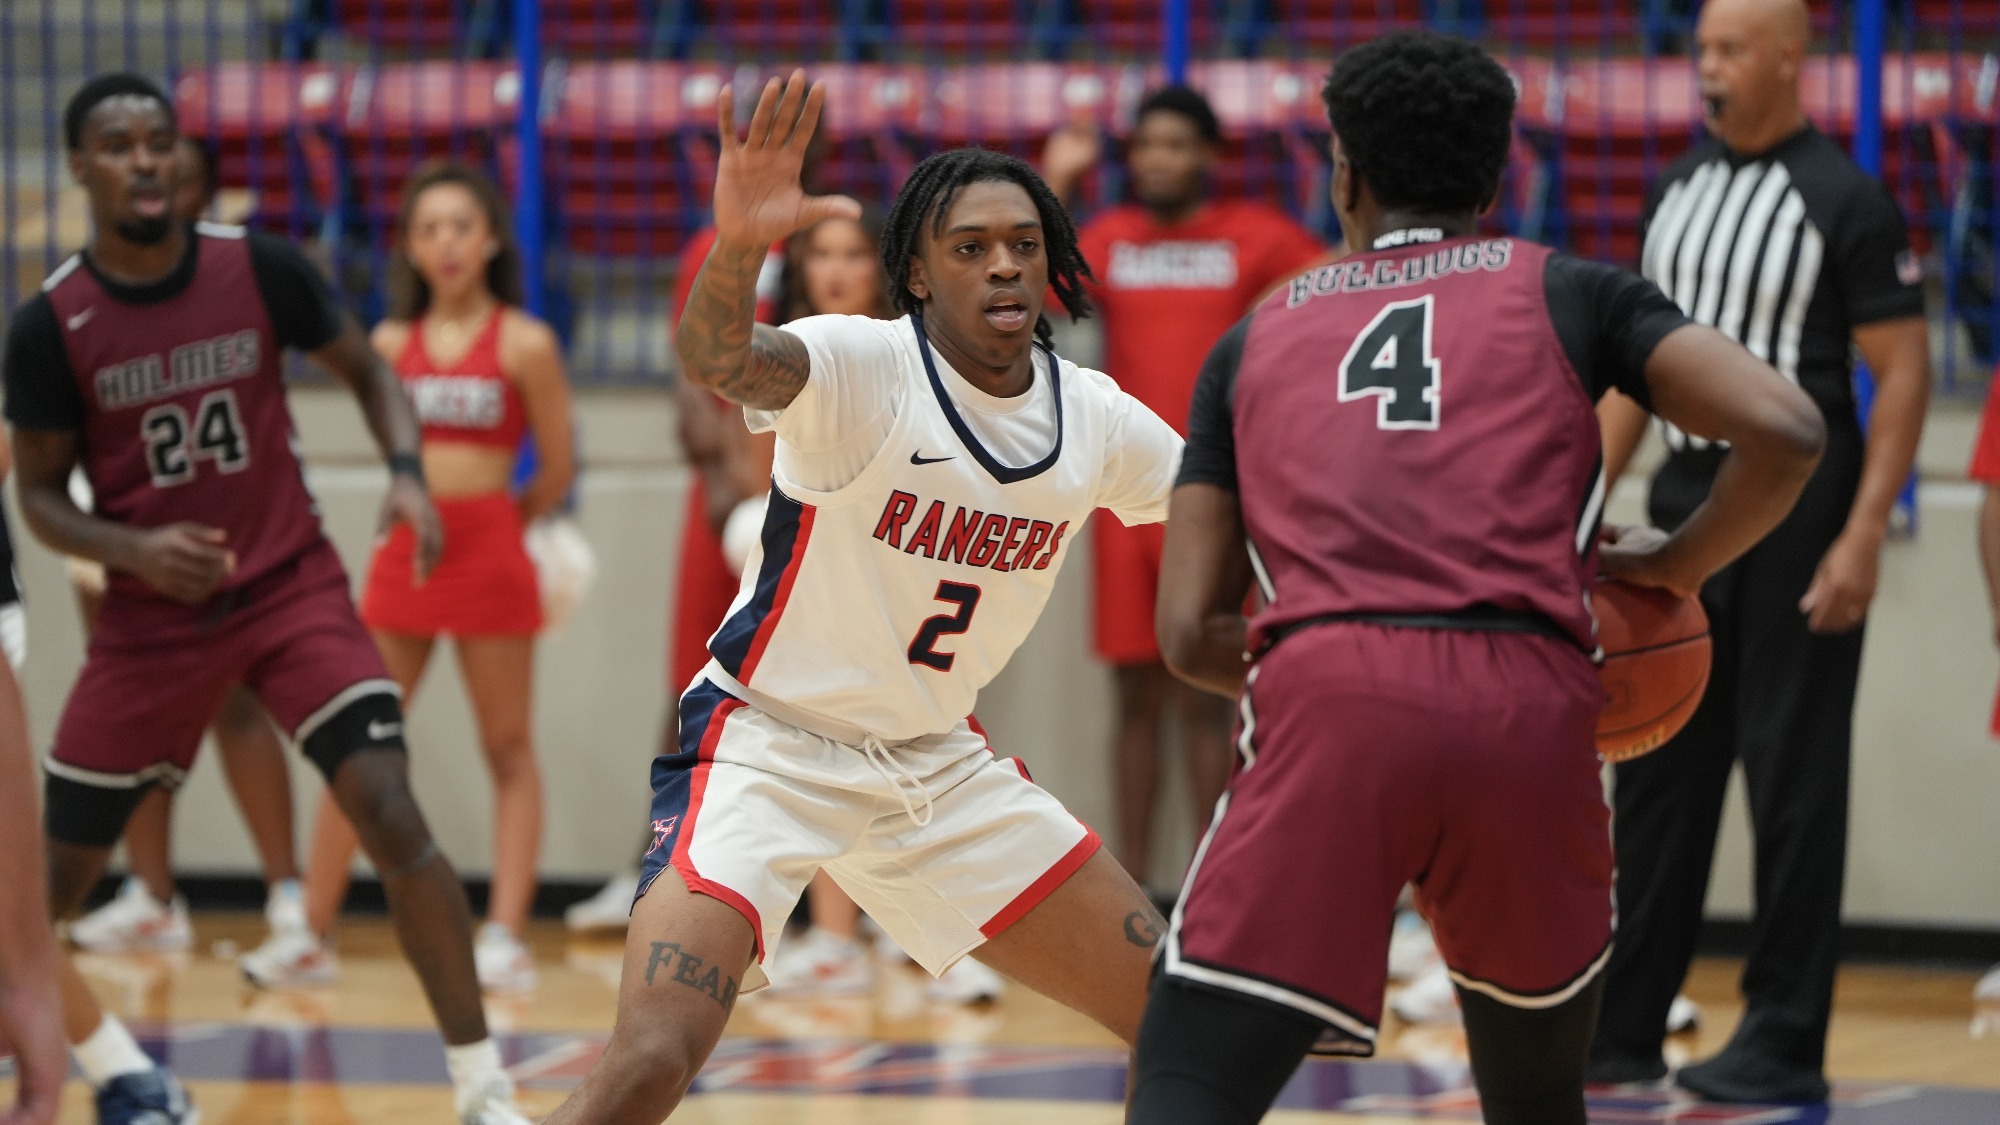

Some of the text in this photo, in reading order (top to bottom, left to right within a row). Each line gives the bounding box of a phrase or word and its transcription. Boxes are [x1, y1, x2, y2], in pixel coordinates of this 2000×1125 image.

[1287, 238, 1513, 309] BULLDOGS
[94, 328, 260, 412] HOLMES
[1337, 293, 1441, 431] 4
[140, 387, 250, 488] 24
[872, 489, 1070, 573] RANGERS
[907, 579, 982, 673] 2
